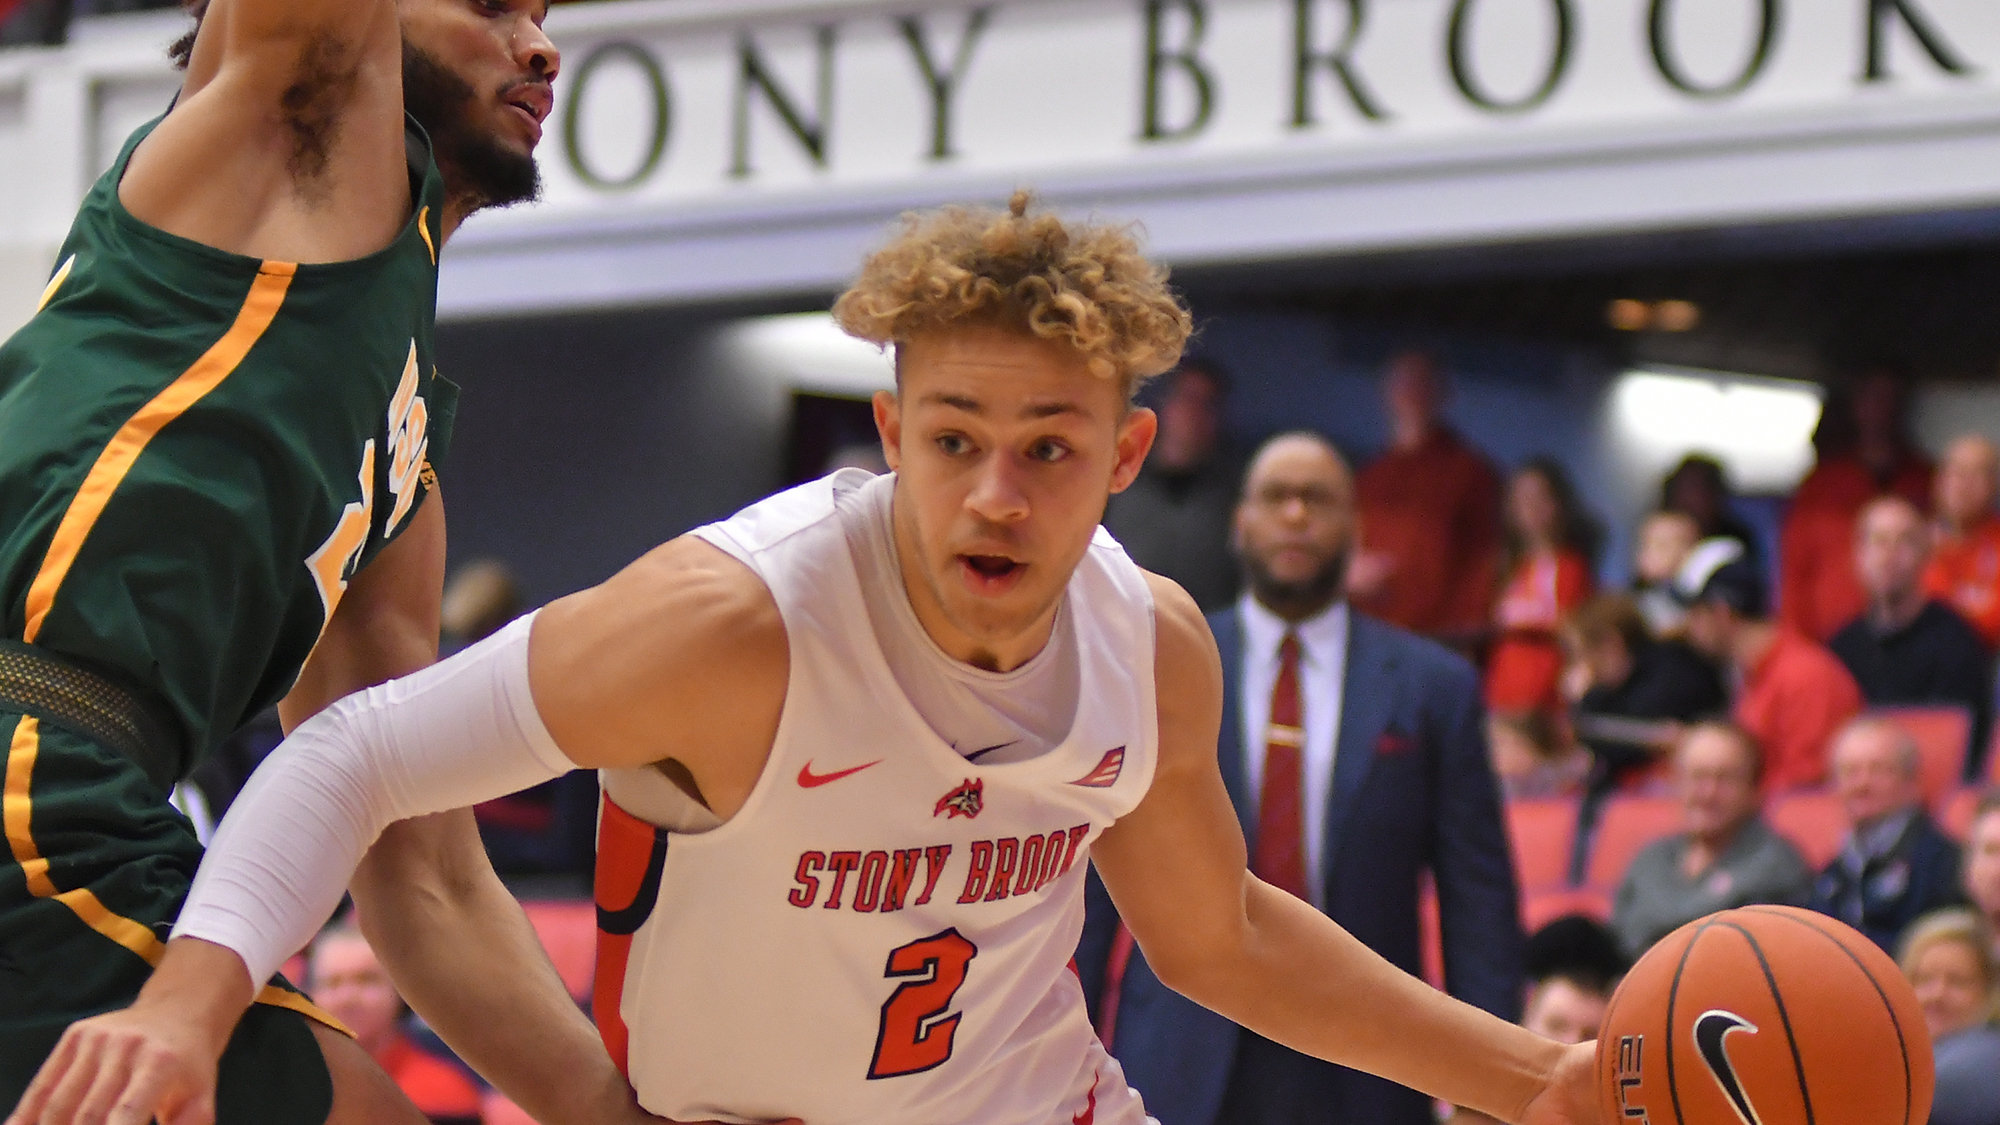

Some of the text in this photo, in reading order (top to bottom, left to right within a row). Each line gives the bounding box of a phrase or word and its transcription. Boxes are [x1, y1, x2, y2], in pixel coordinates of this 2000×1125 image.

[563, 3, 990, 191] ONY
[788, 822, 1090, 913] STONY BROOK
[866, 926, 978, 1080] 2
[1618, 1034, 1650, 1125] ELI
